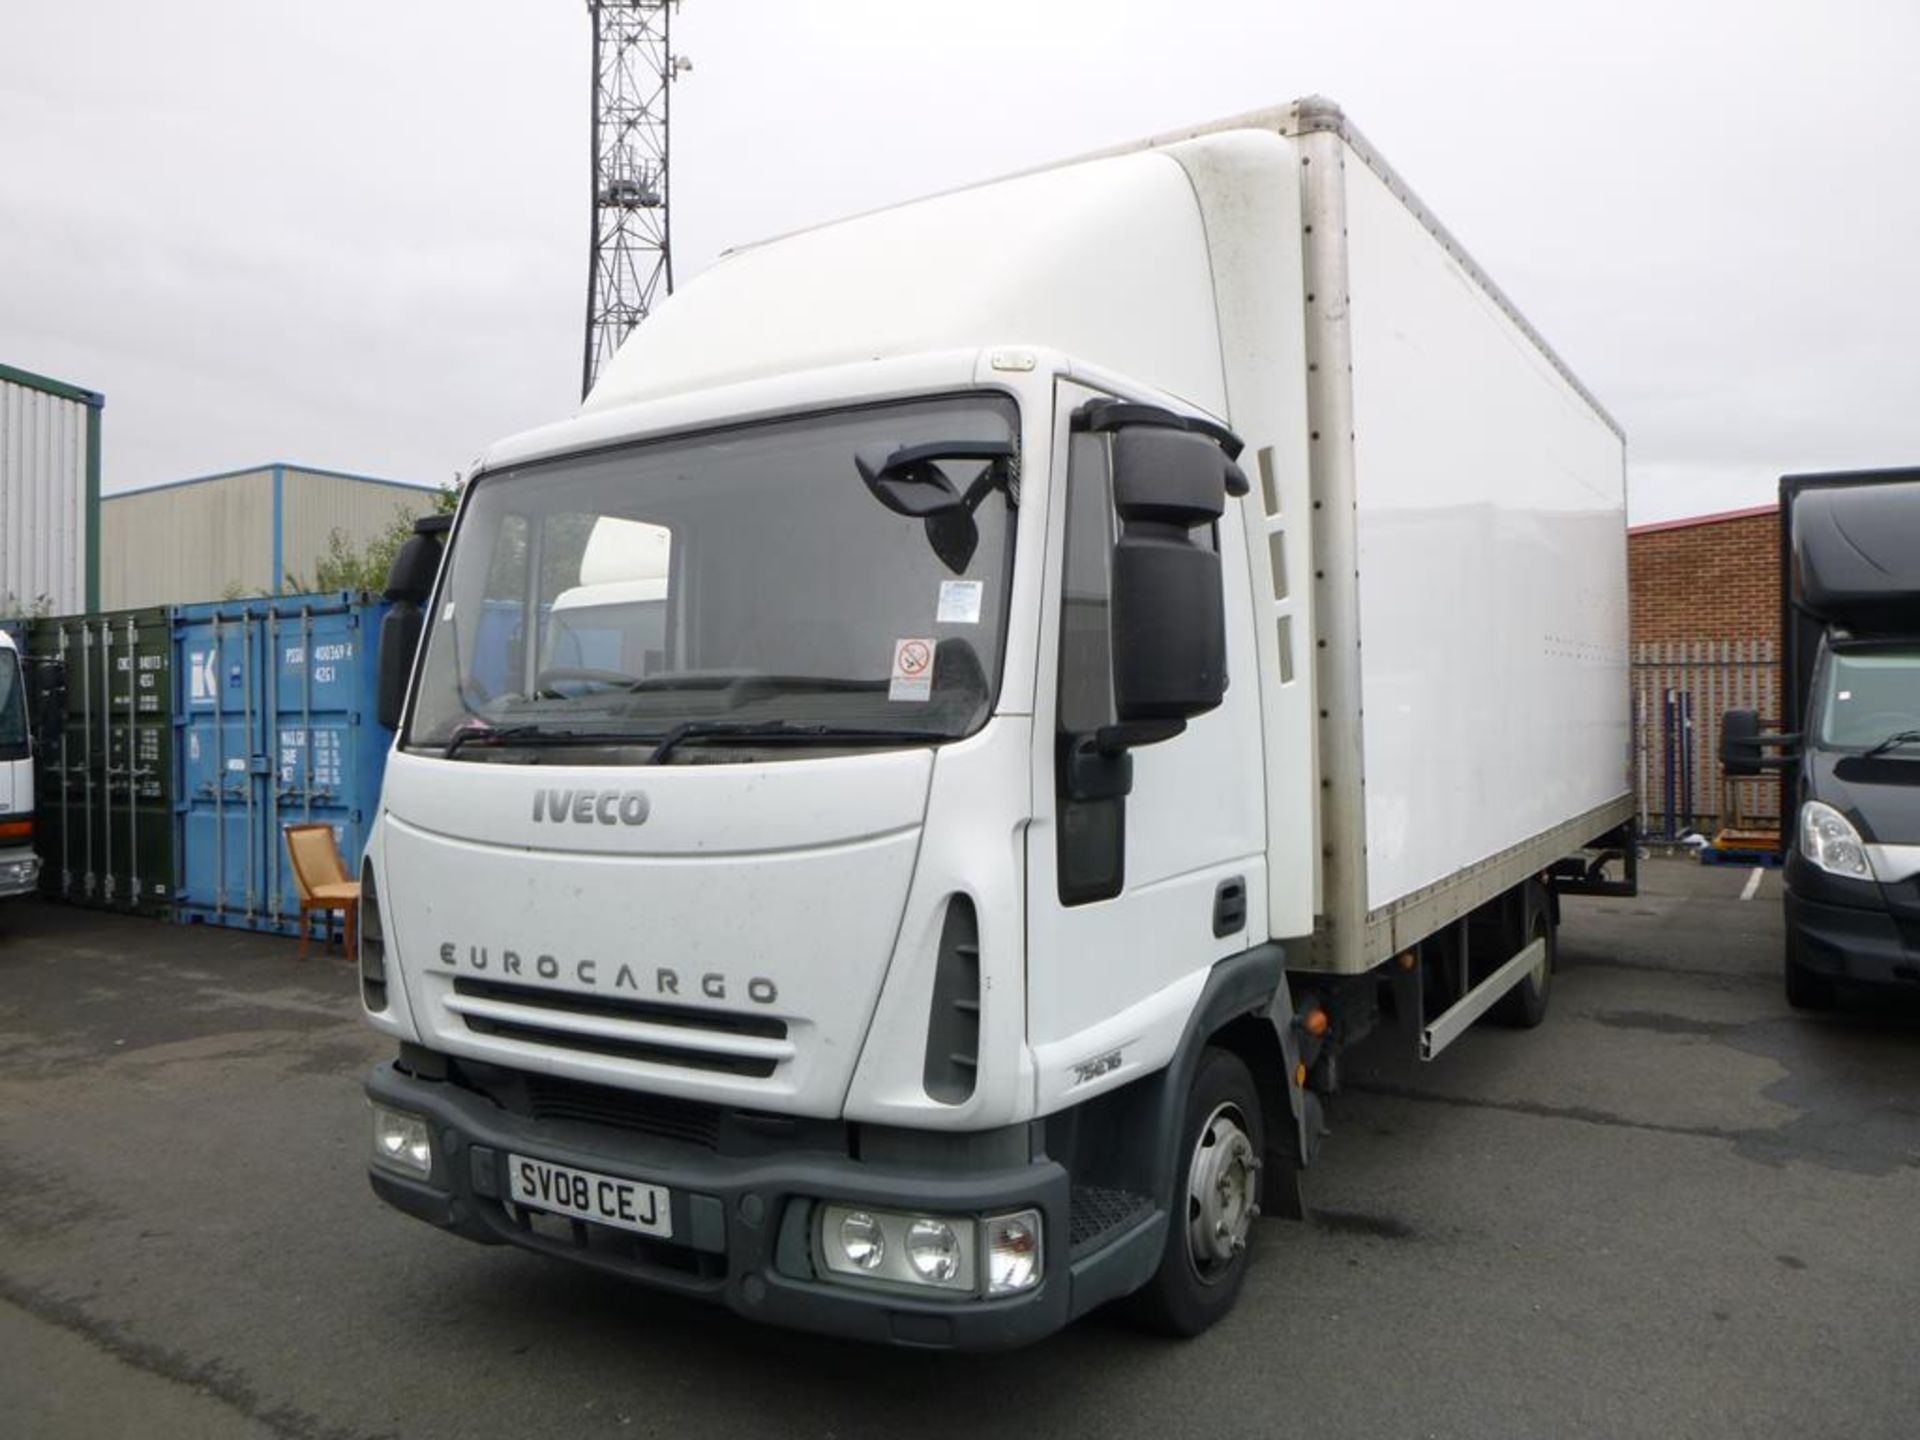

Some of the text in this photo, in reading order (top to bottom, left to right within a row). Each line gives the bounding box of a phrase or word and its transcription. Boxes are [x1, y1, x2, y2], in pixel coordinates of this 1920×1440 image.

[532, 789, 650, 826] IVECO
[440, 942, 778, 1003] EUROCARGO
[520, 1162, 658, 1226] SV08 CEJ
